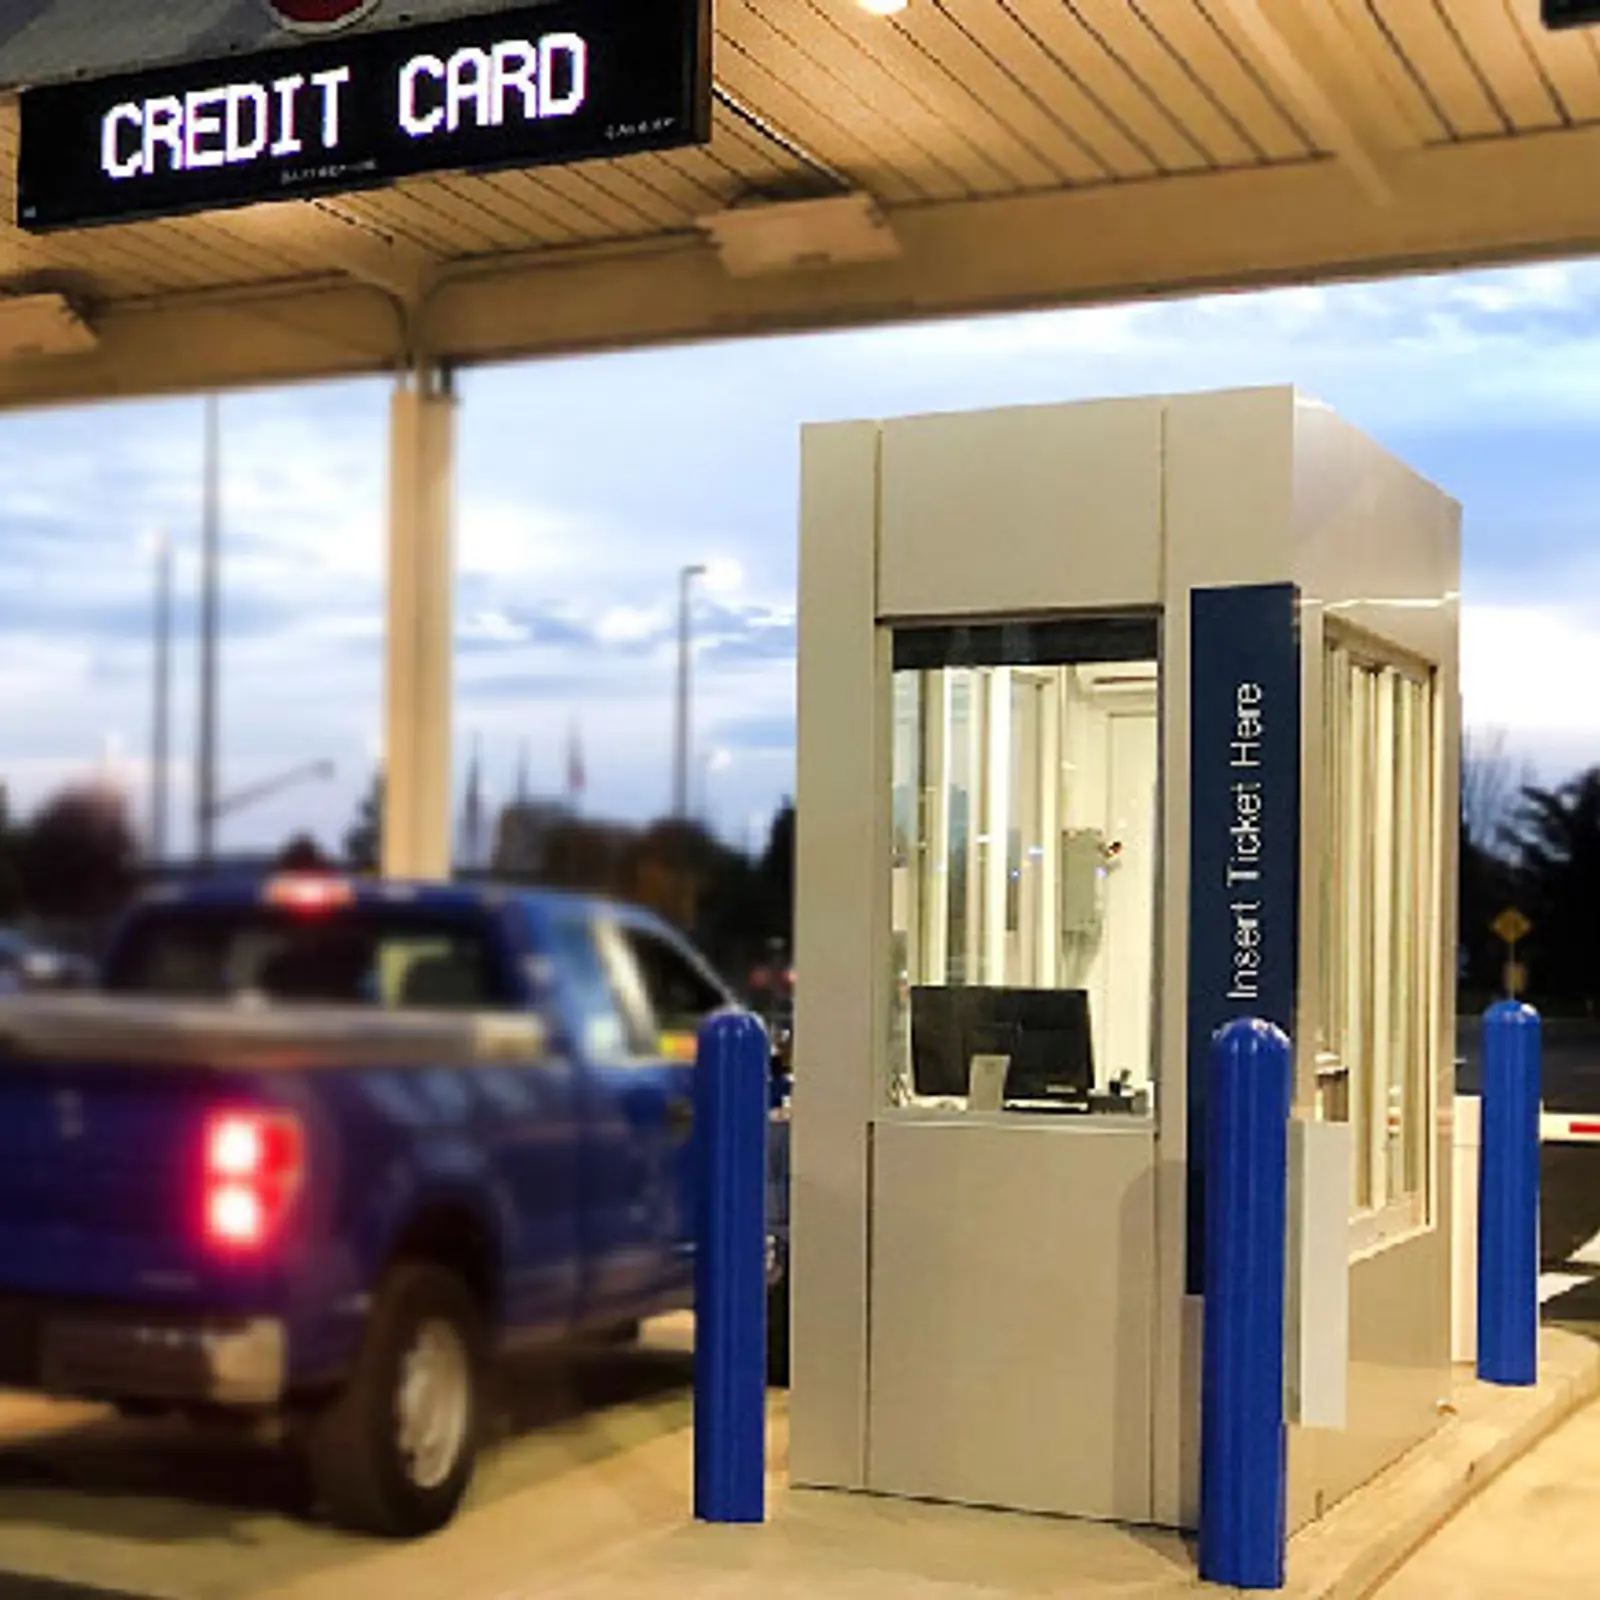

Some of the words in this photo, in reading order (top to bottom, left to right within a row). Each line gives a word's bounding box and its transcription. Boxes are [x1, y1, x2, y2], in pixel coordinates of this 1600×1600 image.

[101, 66, 350, 179] CREDIT
[398, 32, 587, 137] CARD
[1230, 682, 1263, 767] Here
[1226, 781, 1261, 888] Ticket
[1226, 901, 1261, 998] Insert
